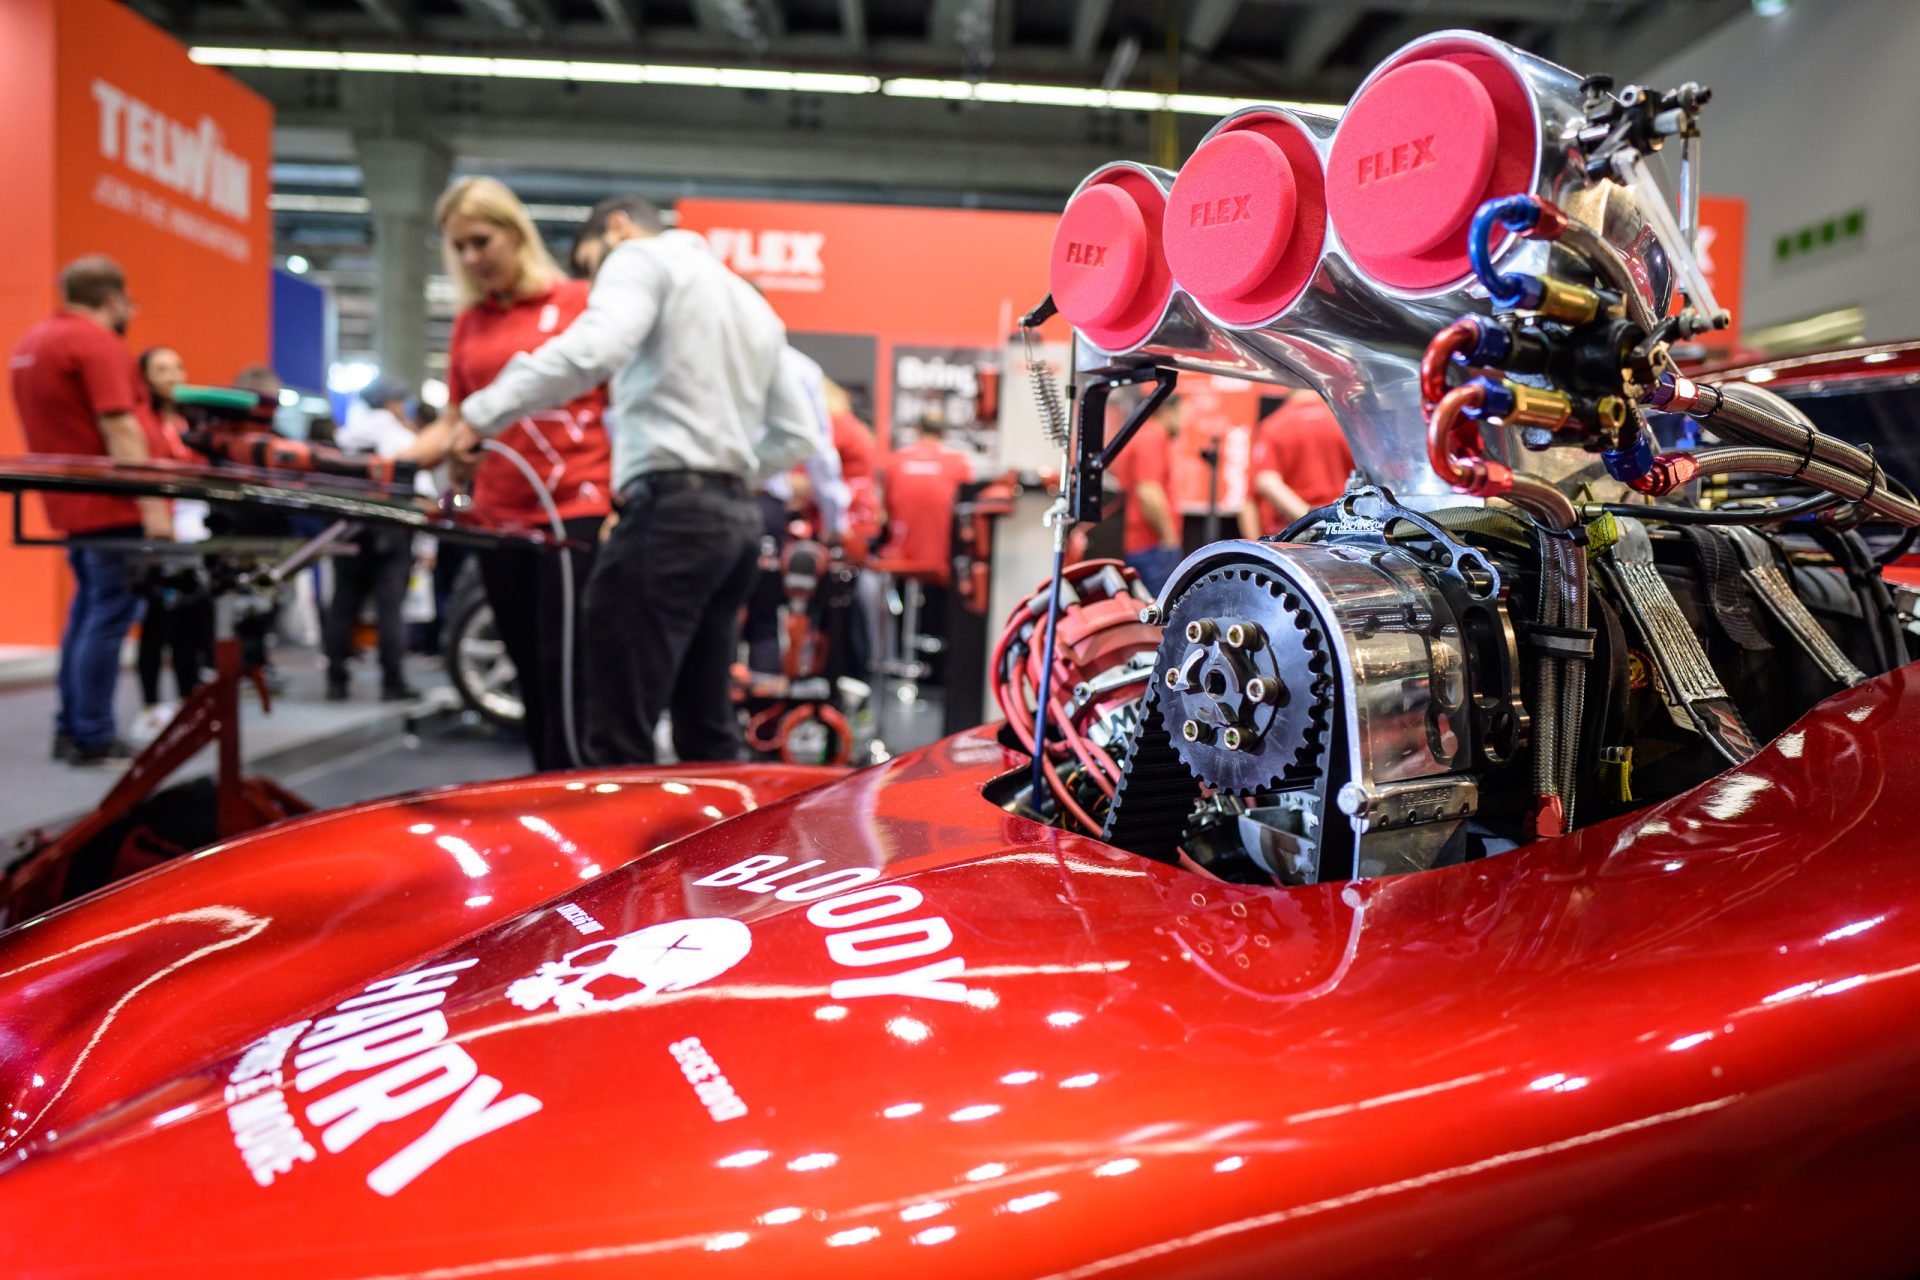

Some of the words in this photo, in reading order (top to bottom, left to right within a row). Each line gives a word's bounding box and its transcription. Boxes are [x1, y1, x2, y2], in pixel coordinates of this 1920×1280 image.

[91, 77, 252, 222] TELWIN
[1358, 135, 1437, 186] FLEX
[1190, 194, 1252, 228] FLEX
[706, 227, 826, 274] FLEX
[1066, 242, 1107, 267] FLEX
[692, 855, 968, 1003] BLOODY
[294, 957, 544, 1197] HARRY
